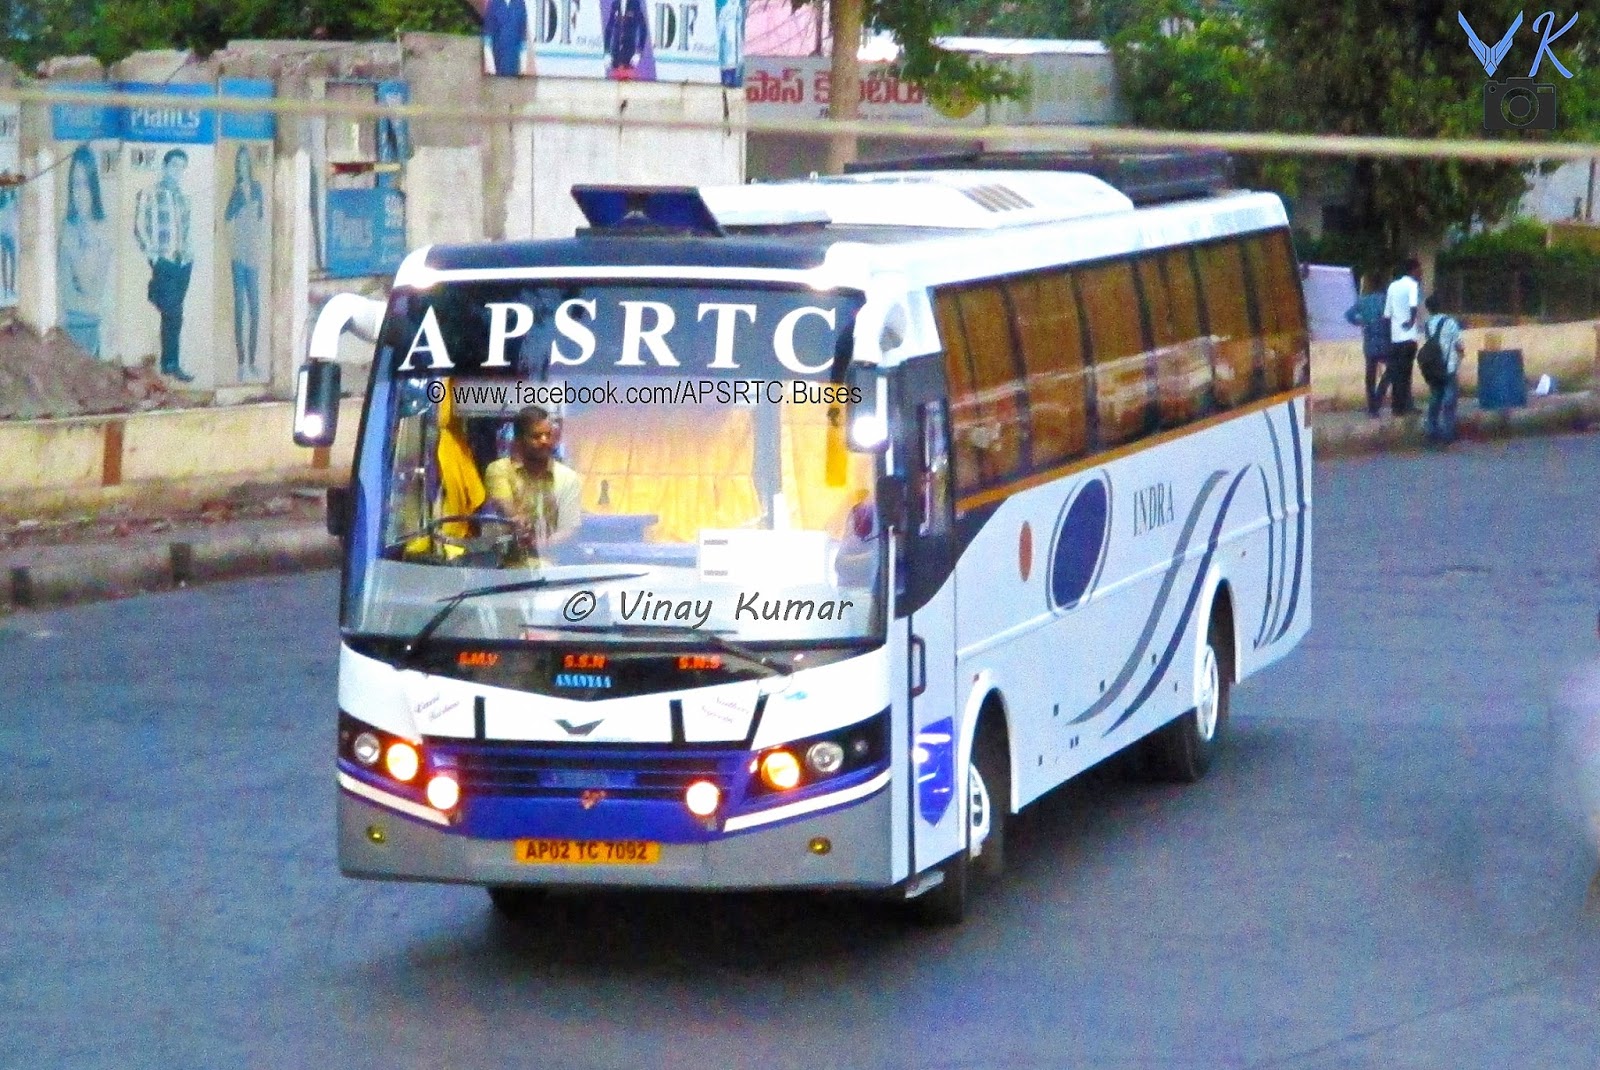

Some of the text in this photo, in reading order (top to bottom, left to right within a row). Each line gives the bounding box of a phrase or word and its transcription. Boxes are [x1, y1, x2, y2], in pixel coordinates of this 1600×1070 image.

[652, 3, 699, 51] DF
[398, 298, 838, 374] APSRTC
[1133, 481, 1174, 537] INDRA
[526, 842, 647, 860] AP02 TC 7092
